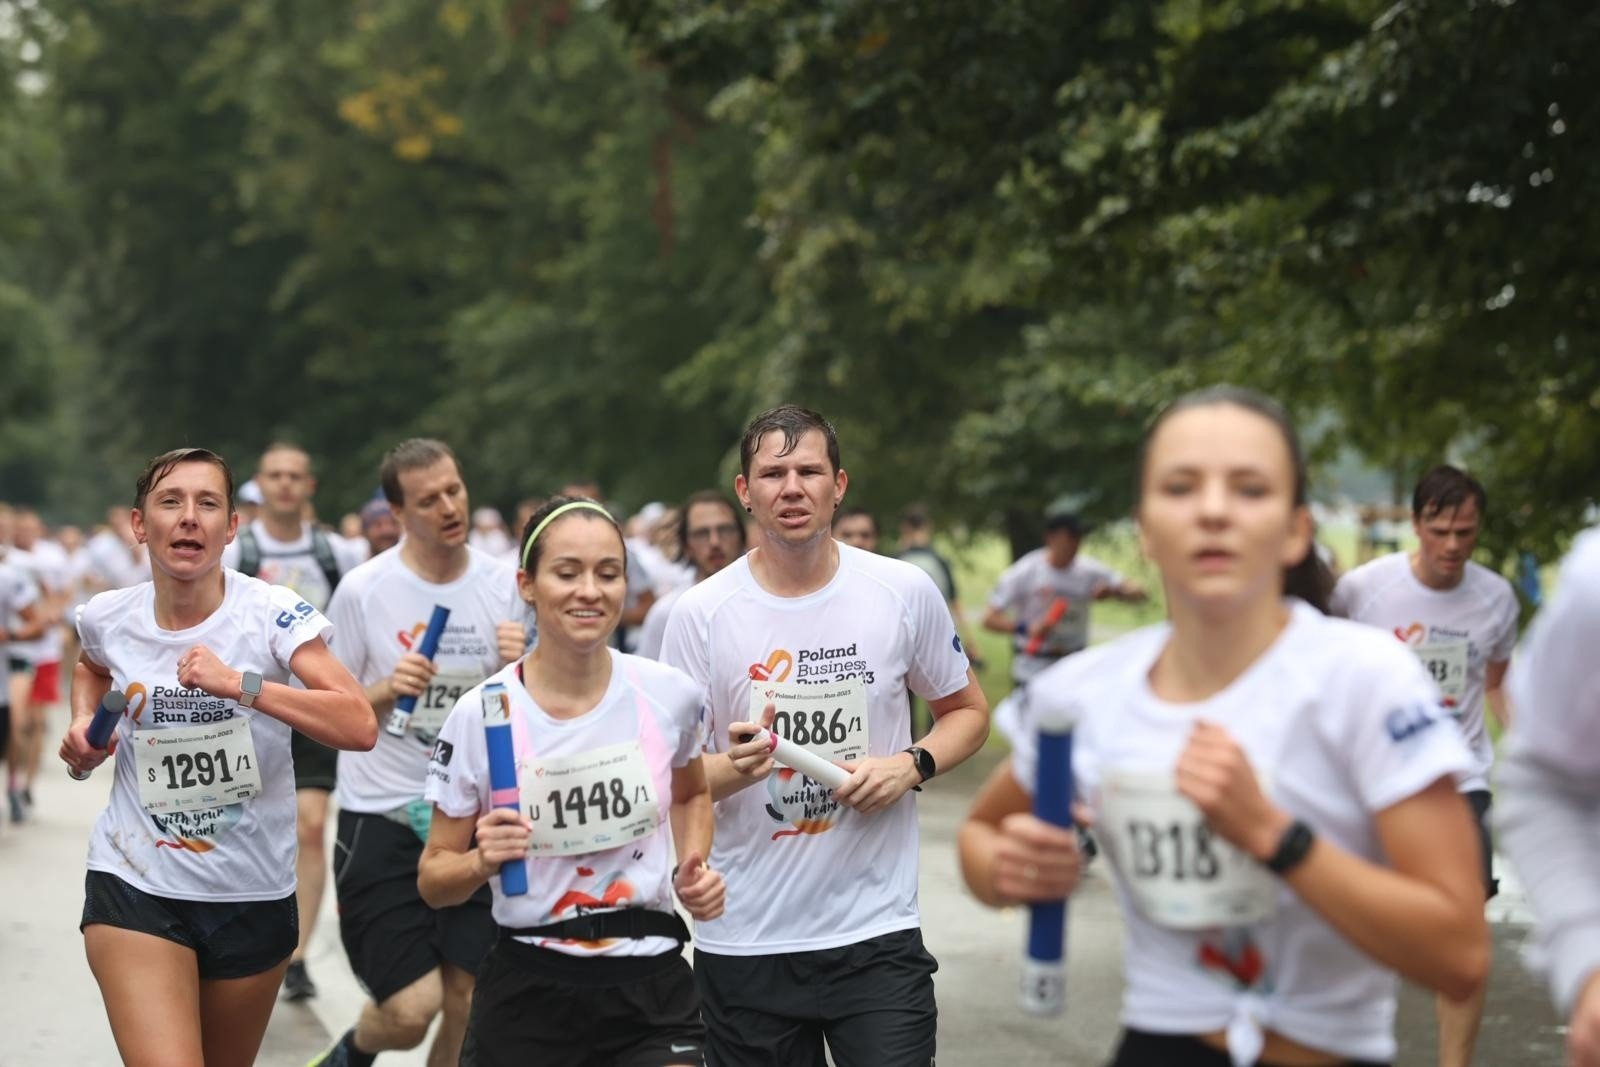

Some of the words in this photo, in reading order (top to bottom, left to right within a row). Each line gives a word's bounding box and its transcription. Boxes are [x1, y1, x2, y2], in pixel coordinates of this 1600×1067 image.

[797, 643, 857, 663] Poland
[797, 660, 867, 678] Business
[423, 686, 474, 709] 124
[774, 692, 797, 700] Poland
[823, 691, 836, 699] Run
[837, 689, 852, 698] 2023
[152, 699, 225, 712] Business
[152, 711, 187, 723] Run
[190, 708, 235, 723] 2023
[204, 733, 217, 741] Run
[217, 729, 234, 738] 2023
[781, 787, 815, 804] with
[820, 788, 834, 802] yo
[160, 810, 190, 826] with
[193, 808, 225, 826] your
[529, 804, 540, 821] U
[179, 824, 218, 839] heart
